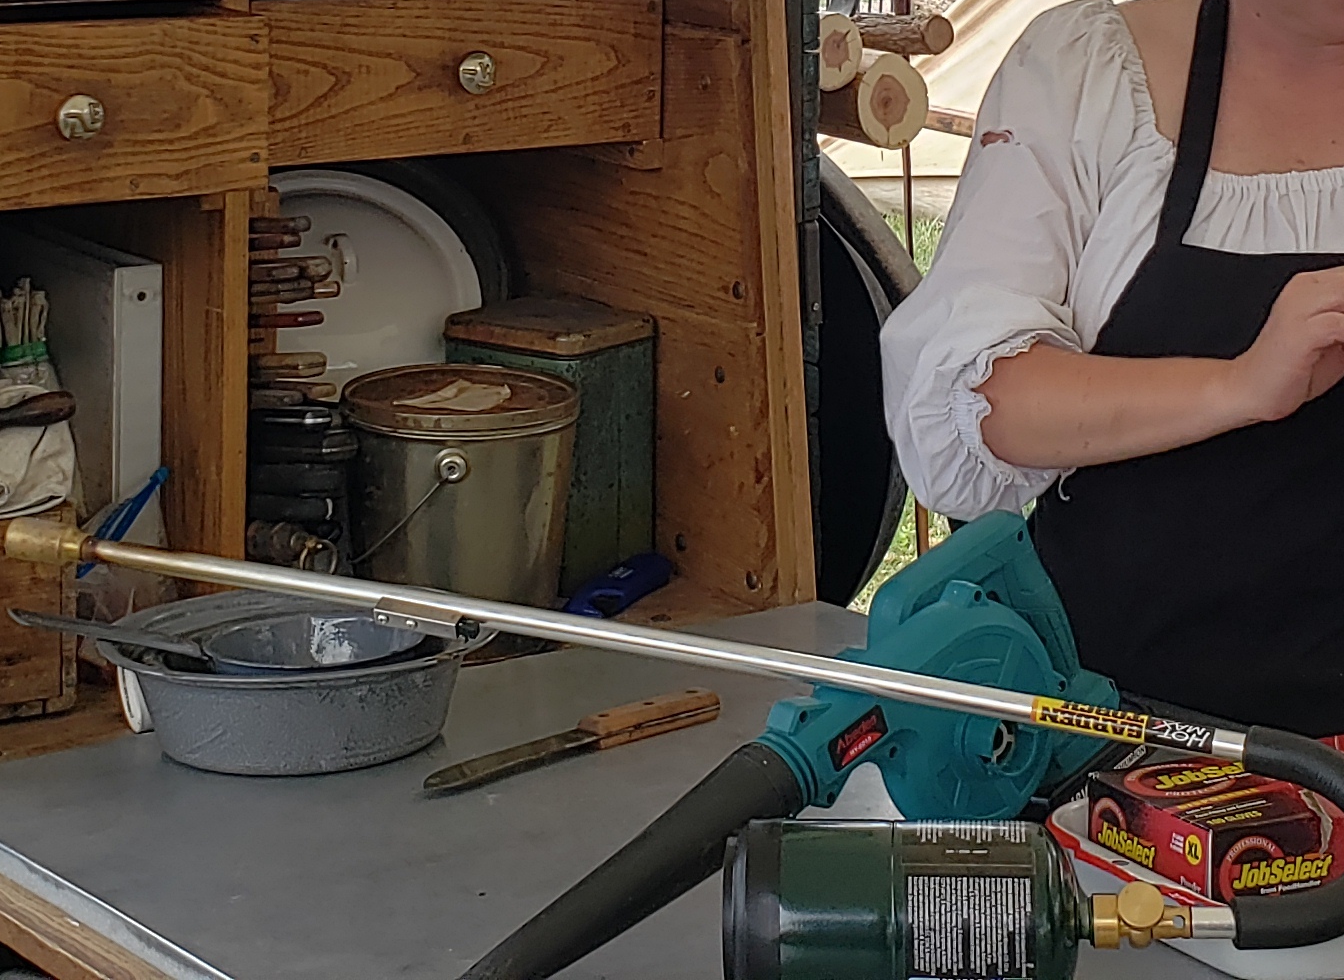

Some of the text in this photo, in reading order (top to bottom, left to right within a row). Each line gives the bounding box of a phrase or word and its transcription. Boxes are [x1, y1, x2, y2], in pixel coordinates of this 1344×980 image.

[1039, 705, 1143, 739] GARDEN
[1155, 720, 1207, 736] MAX
[1157, 728, 1211, 748] HOT
[1155, 761, 1245, 790] JobSel
[1098, 822, 1156, 869] JobSelect
[1187, 840, 1200, 861] XL
[1226, 837, 1277, 862] PROFESSIONAL
[1232, 854, 1333, 890] JobSelect
